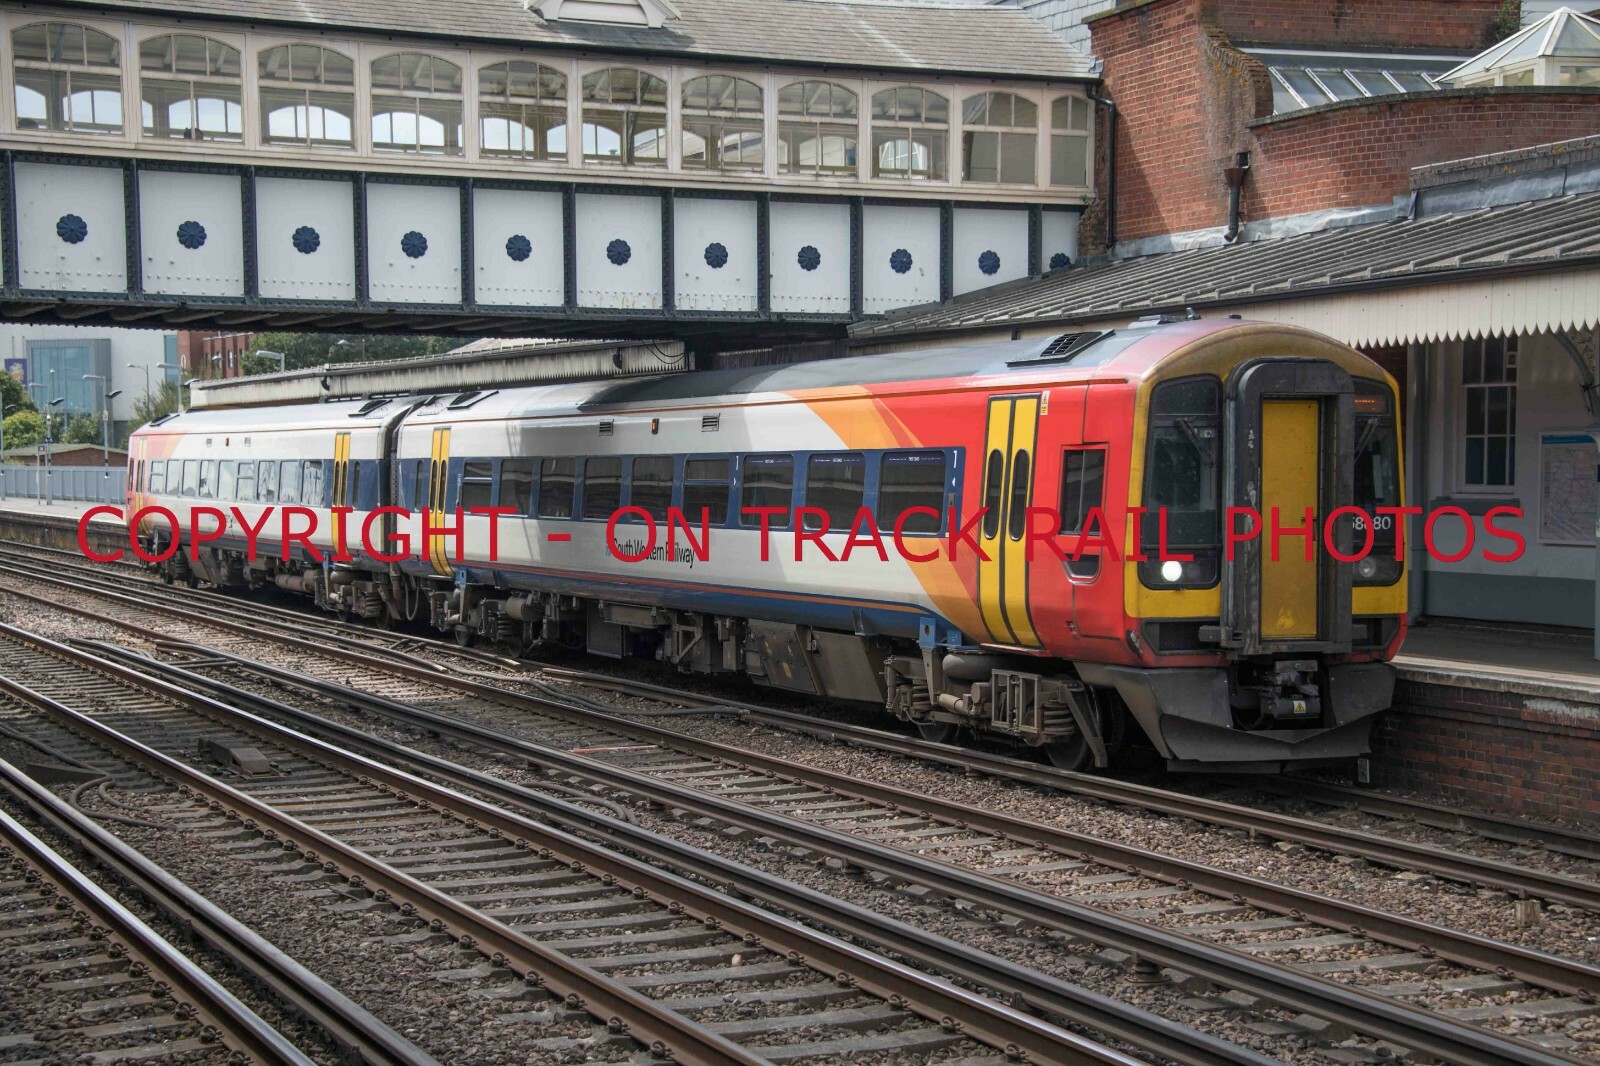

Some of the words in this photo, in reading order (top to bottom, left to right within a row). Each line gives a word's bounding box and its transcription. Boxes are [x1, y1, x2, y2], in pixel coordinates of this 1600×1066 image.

[1352, 516, 1391, 530] 880
[634, 540, 665, 561] Wetern
[666, 542, 695, 569] ilway
